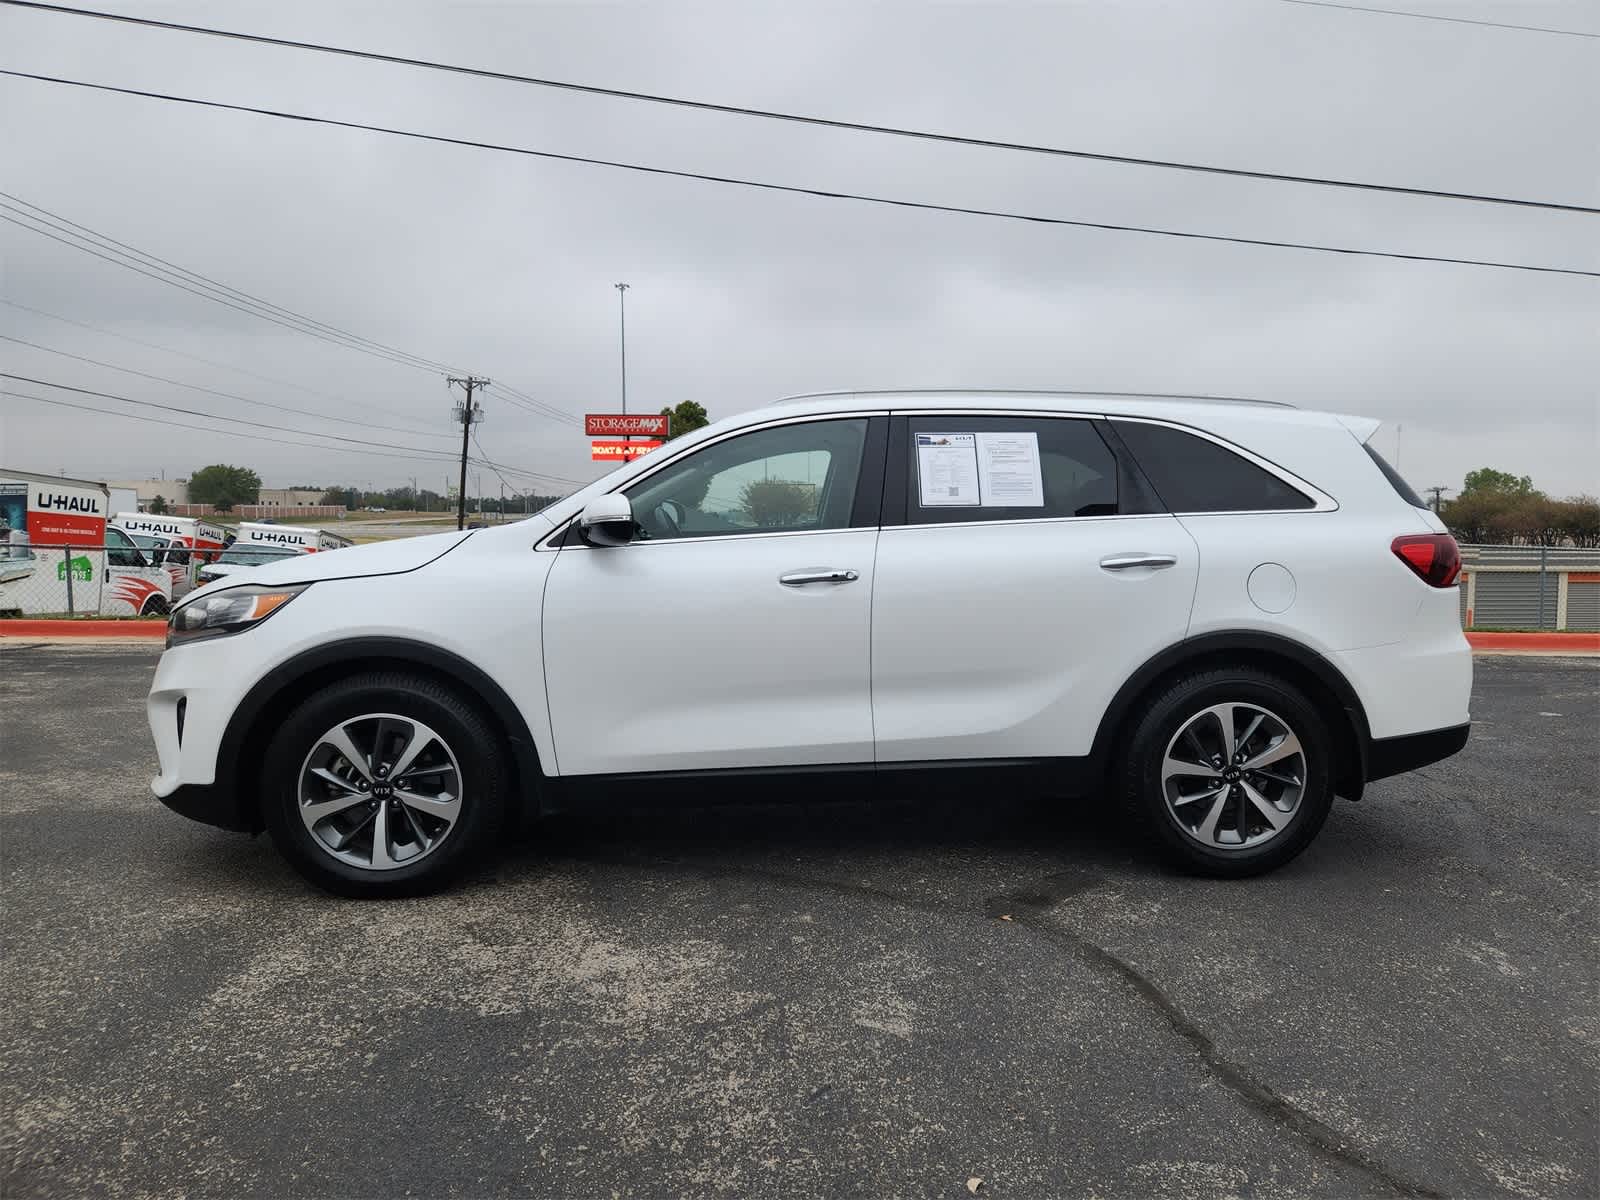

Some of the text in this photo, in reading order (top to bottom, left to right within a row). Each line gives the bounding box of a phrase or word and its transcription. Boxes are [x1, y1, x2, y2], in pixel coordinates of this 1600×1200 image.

[588, 417, 664, 432] STORAGEMAX
[592, 446, 615, 454] BOAT
[38, 492, 100, 513] U-HAUL
[125, 521, 182, 534] U-HAUL
[251, 531, 306, 545] U-HAUL
